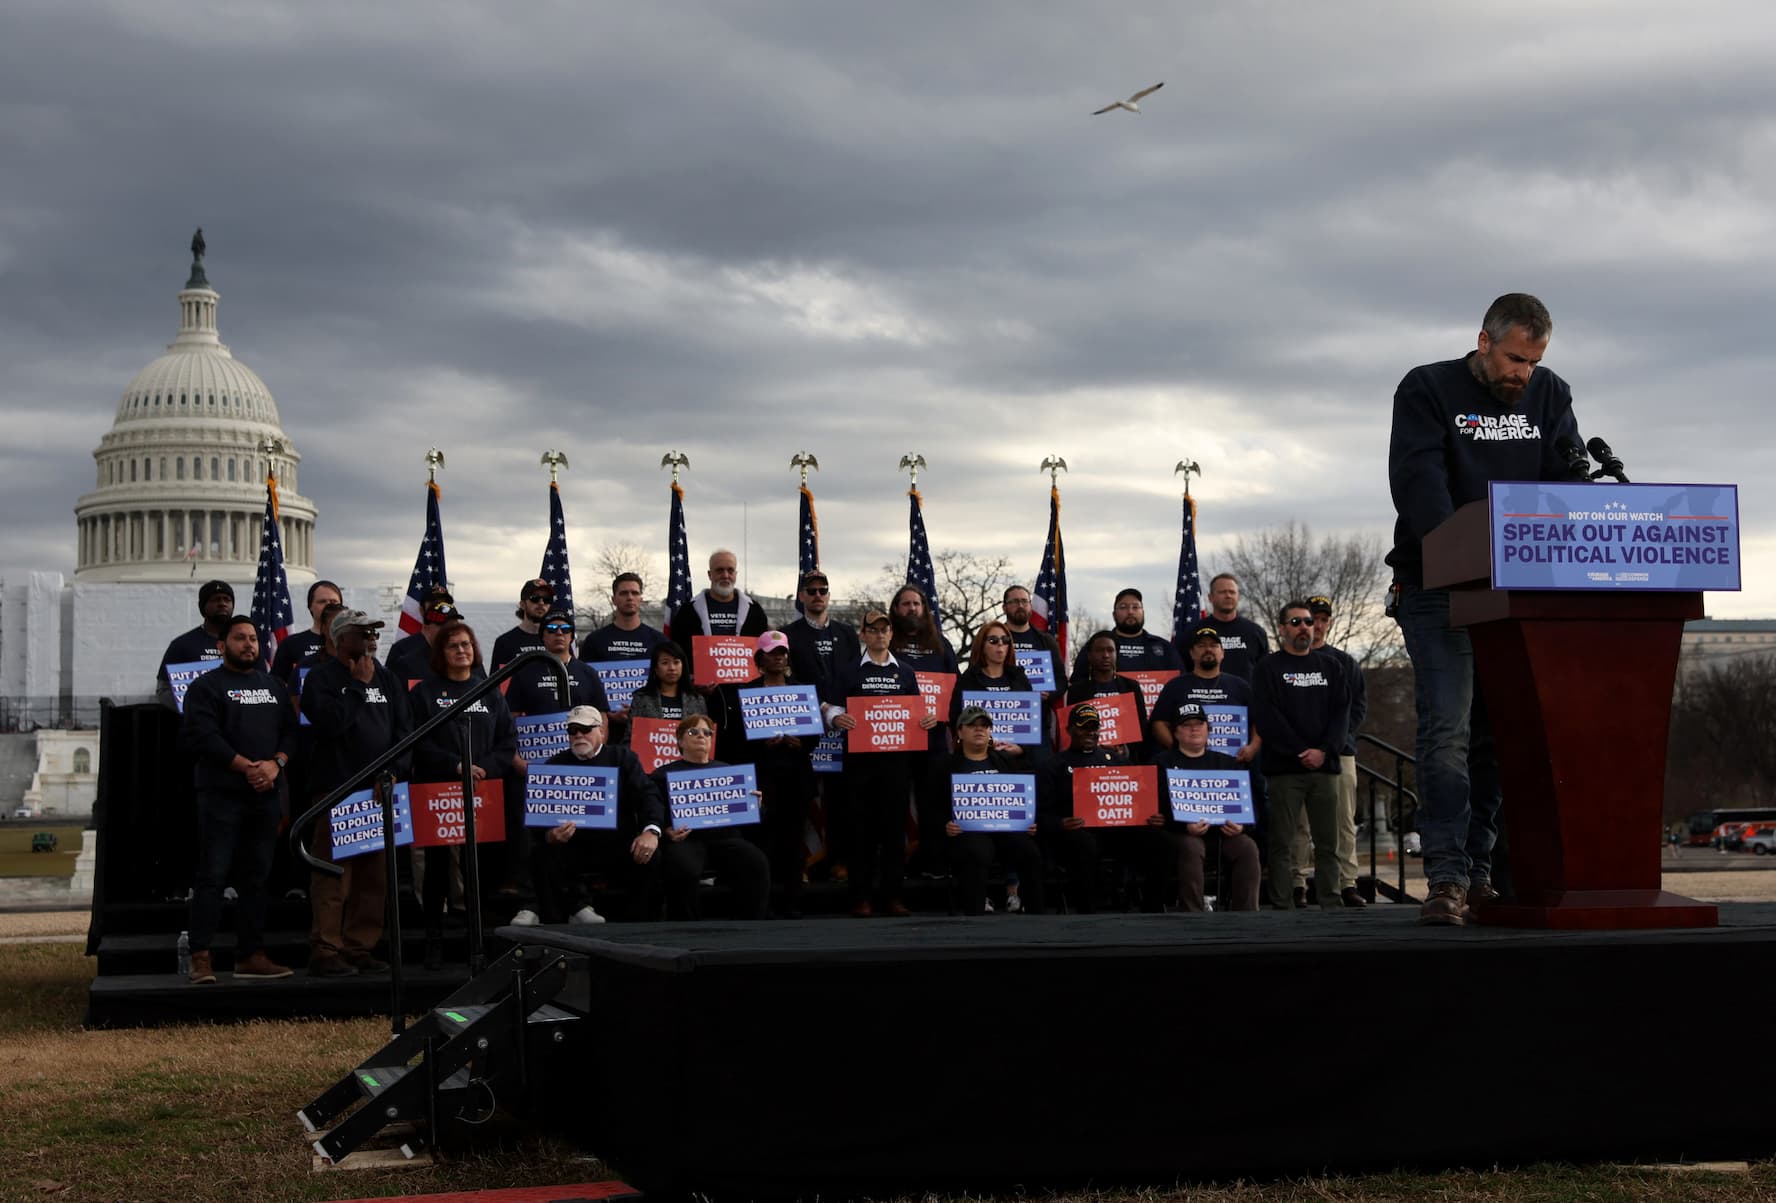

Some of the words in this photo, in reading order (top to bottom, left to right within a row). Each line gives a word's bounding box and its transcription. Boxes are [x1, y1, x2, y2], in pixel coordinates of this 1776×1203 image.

[1455, 414, 1529, 428] COURAGE
[1473, 426, 1541, 440] AMERICA
[1568, 511, 1590, 520] NOT
[1591, 511, 1607, 520] ON
[1608, 512, 1628, 521] OUR
[1629, 512, 1664, 521] WATCH
[1503, 523, 1576, 541] SPEAK
[1582, 524, 1626, 542] OUT
[1632, 525, 1729, 543] AGAINST
[1504, 545, 1616, 564] POLITICAL
[1620, 546, 1730, 565] VIOLENCE
[709, 647, 753, 657] HONOR
[715, 658, 748, 667] YOUR
[1015, 658, 1034, 666] TOP
[170, 671, 192, 681] PUT
[193, 671, 199, 679] A
[618, 668, 645, 677] STOP
[716, 668, 749, 678] OATH
[172, 683, 188, 692] TO
[604, 680, 648, 690] POLITIC
[1293, 678, 1328, 687] AMERICA
[918, 684, 941, 694] NOR
[239, 696, 278, 704] AMERICA
[607, 692, 633, 701] LENC
[741, 696, 761, 706] PUT
[771, 694, 798, 703] STOP
[963, 700, 983, 708] PUT
[994, 700, 1020, 708] STOP
[1178, 703, 1200, 715] NAVY
[744, 709, 758, 717] TO
[759, 705, 810, 716] POLITICAL
[864, 710, 910, 720] HONOR
[991, 712, 1030, 721] LITICAL
[745, 717, 796, 729] VIOLENCE
[1207, 714, 1233, 722] STOP
[517, 725, 537, 734] PUT
[538, 724, 546, 733] A
[547, 721, 568, 732] STO
[871, 722, 905, 732] YOUR
[518, 738, 532, 747] TO
[649, 732, 678, 743] HON
[871, 734, 905, 745] OATH
[655, 746, 681, 757] YOU
[528, 775, 552, 785] PUT
[554, 776, 563, 785] A
[564, 776, 595, 786] STOP
[669, 780, 691, 791] PUT
[694, 780, 702, 789] A
[703, 776, 734, 788] STOP
[1169, 778, 1190, 787] PUT
[1191, 779, 1199, 787] A
[1200, 779, 1229, 788] STOP
[953, 784, 975, 792] PUT
[977, 784, 985, 792] A
[986, 784, 1015, 793] STOP
[1090, 781, 1138, 793] HONOR
[528, 789, 544, 799] TO
[546, 790, 605, 800] POLITICAL
[671, 795, 687, 805] TO
[688, 789, 745, 804] POLITICAL
[1170, 790, 1184, 799] TO
[1186, 791, 1240, 801] POLITICAL
[429, 796, 483, 811] HONR
[954, 797, 969, 806] TO
[971, 797, 1025, 806] POLITICAL
[1096, 795, 1133, 806] YOUR
[331, 805, 351, 818] PUT
[353, 803, 361, 813] A
[361, 800, 382, 809] STO
[527, 804, 586, 815] VIOLENCE
[673, 804, 729, 818] VIOLENCE
[1172, 802, 1224, 814] VIOLENCE
[436, 812, 476, 824] YOU
[954, 811, 1009, 820] VIOLENCE
[1097, 808, 1133, 820] OATH
[332, 821, 347, 832] TO
[437, 825, 465, 838] OAT
[333, 826, 384, 847] VIOLENCE
